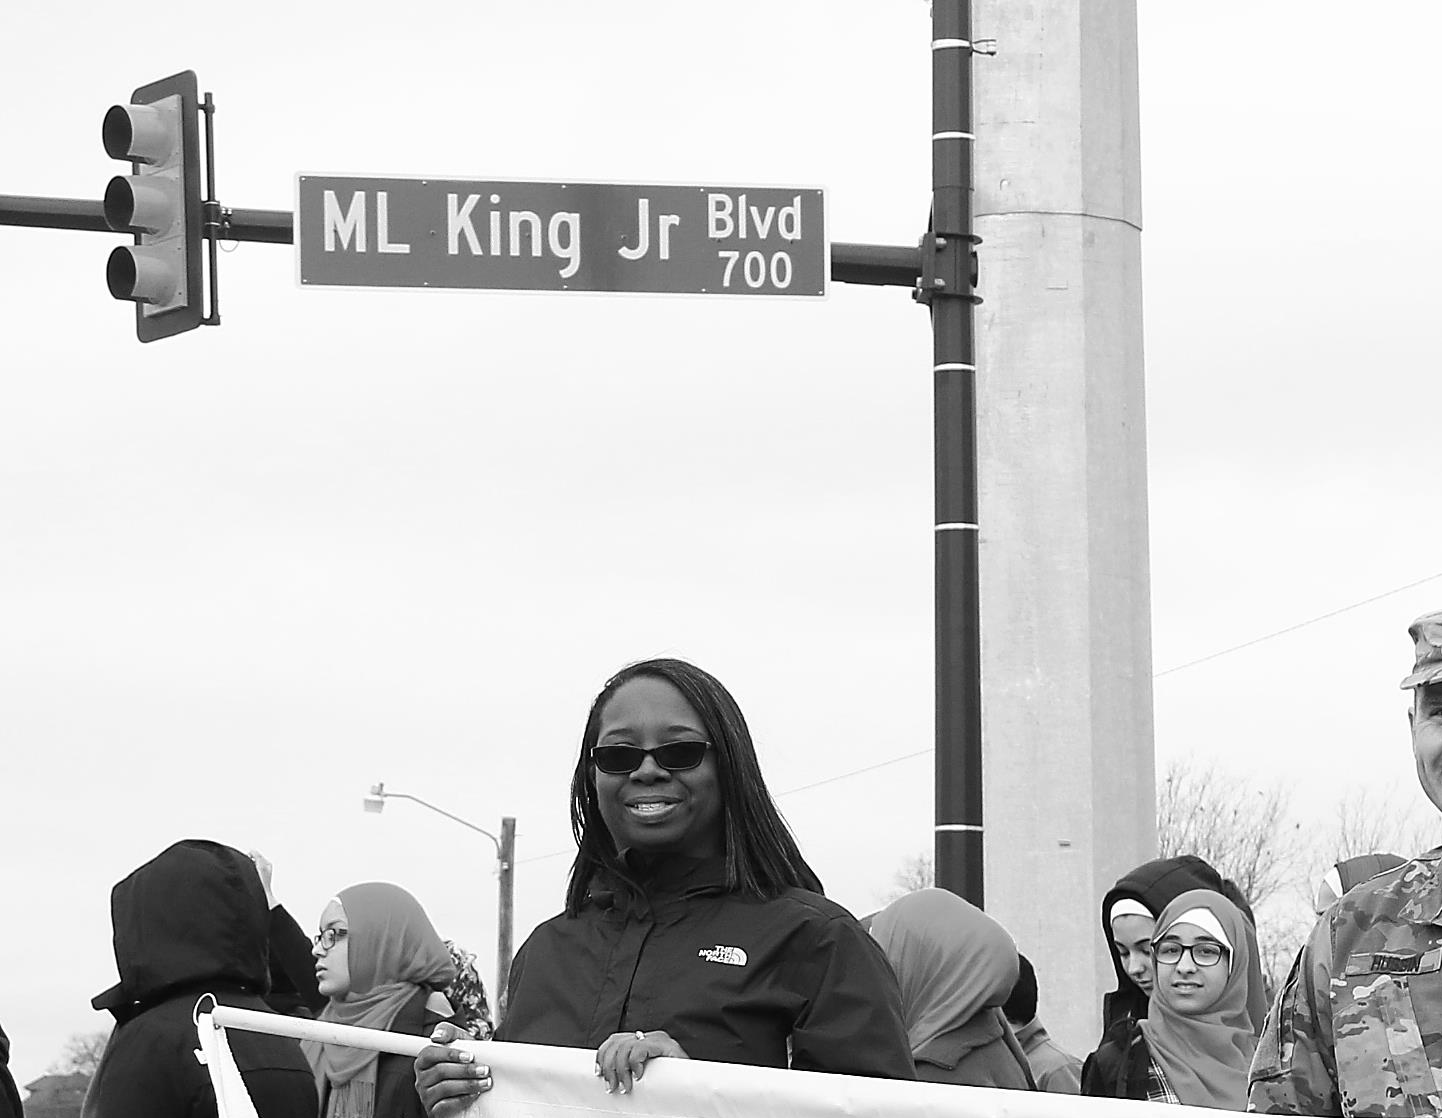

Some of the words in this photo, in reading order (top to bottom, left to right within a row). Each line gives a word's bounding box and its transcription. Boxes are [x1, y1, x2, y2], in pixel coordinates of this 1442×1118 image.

[323, 190, 411, 254] ML
[447, 193, 581, 279] King
[618, 198, 680, 260] Jr
[707, 193, 802, 241] Blvd
[718, 251, 792, 289] 700
